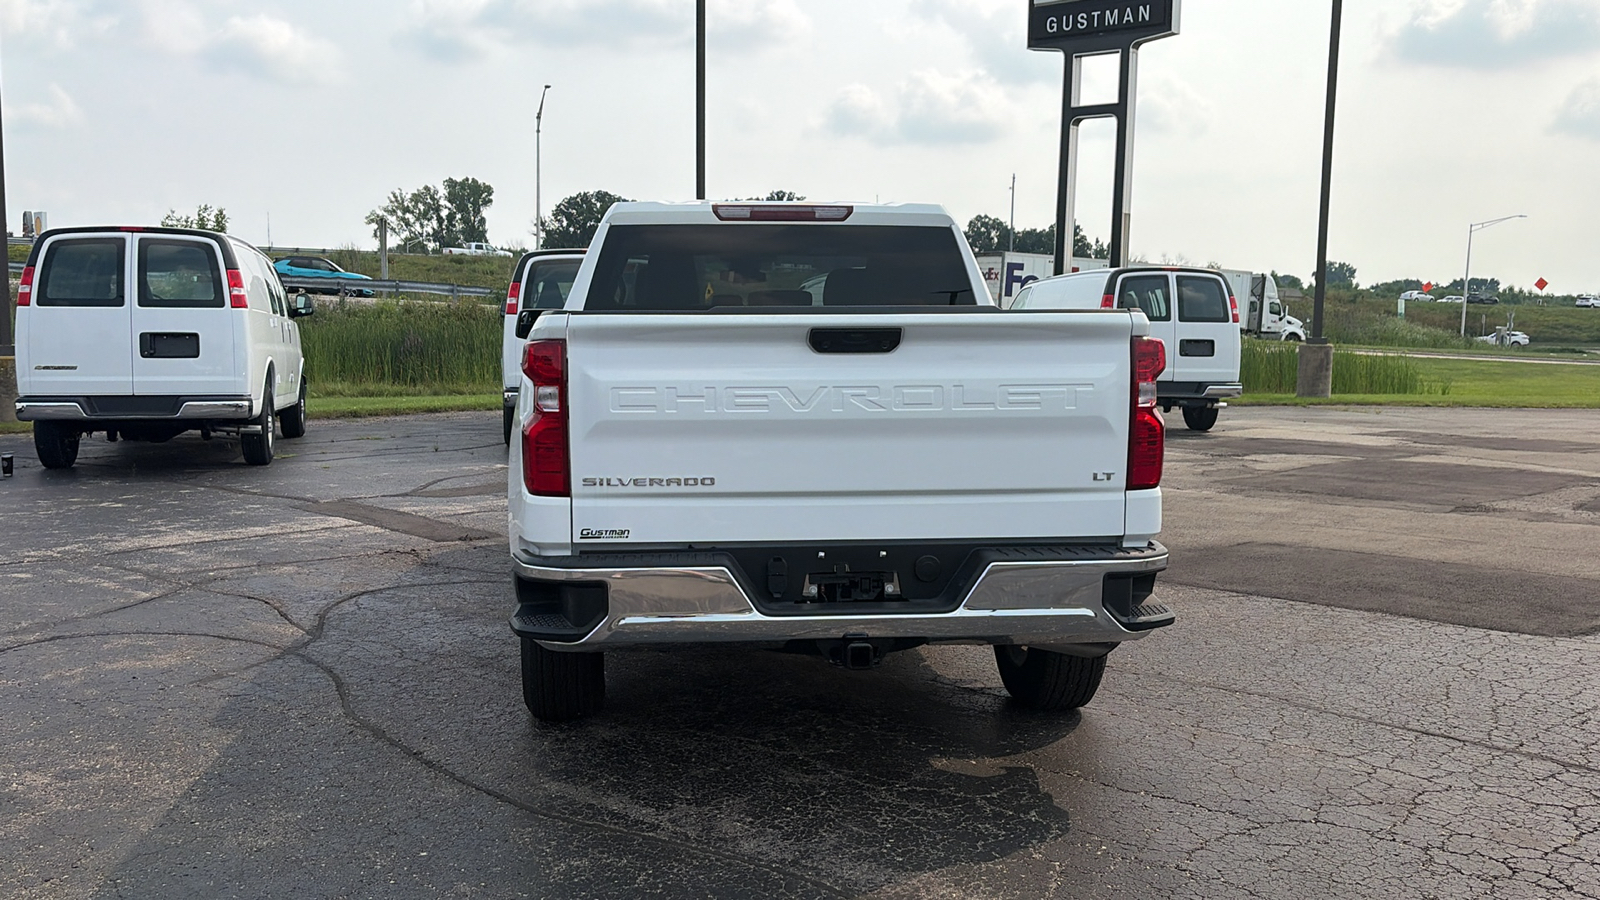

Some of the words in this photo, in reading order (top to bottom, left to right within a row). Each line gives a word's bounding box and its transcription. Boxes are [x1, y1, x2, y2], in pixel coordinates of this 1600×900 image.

[1046, 4, 1150, 33] GUSTMAN
[981, 267, 1000, 281] dEx
[609, 383, 1095, 413] CHEVROLET
[582, 477, 716, 487] SILVERADO
[1092, 472, 1116, 481] LT
